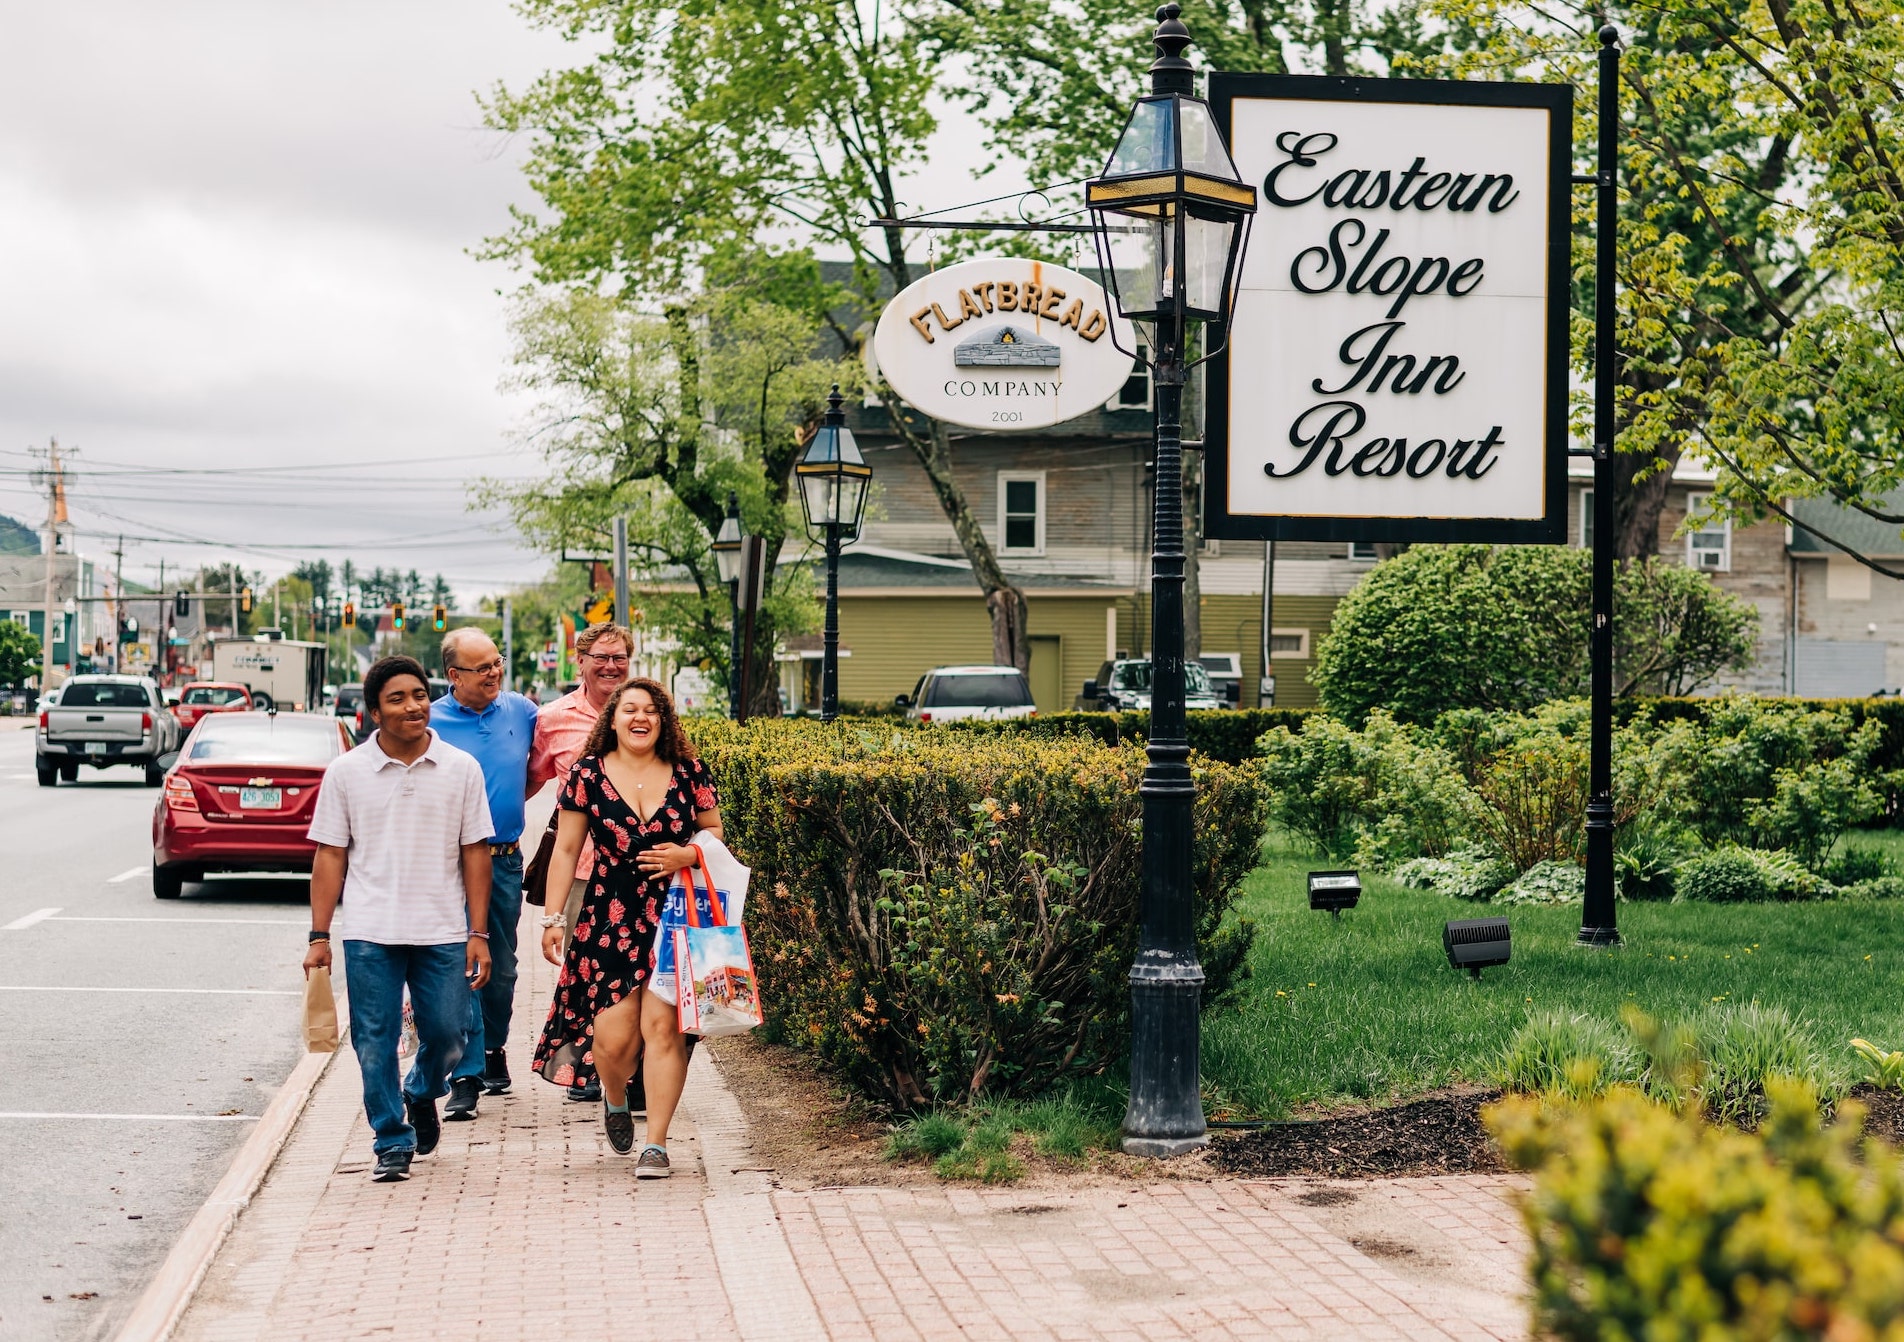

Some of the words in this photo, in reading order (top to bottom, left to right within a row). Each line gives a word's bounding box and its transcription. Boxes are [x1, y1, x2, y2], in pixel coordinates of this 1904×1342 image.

[1264, 131, 1520, 213] Eastern
[1291, 218, 1484, 319] Slope
[909, 281, 1107, 343] FLATBREAD
[944, 380, 1063, 397] COMPANY
[1312, 322, 1466, 395] Inn
[992, 411, 1023, 422] 2001
[1264, 401, 1505, 480] Resort
